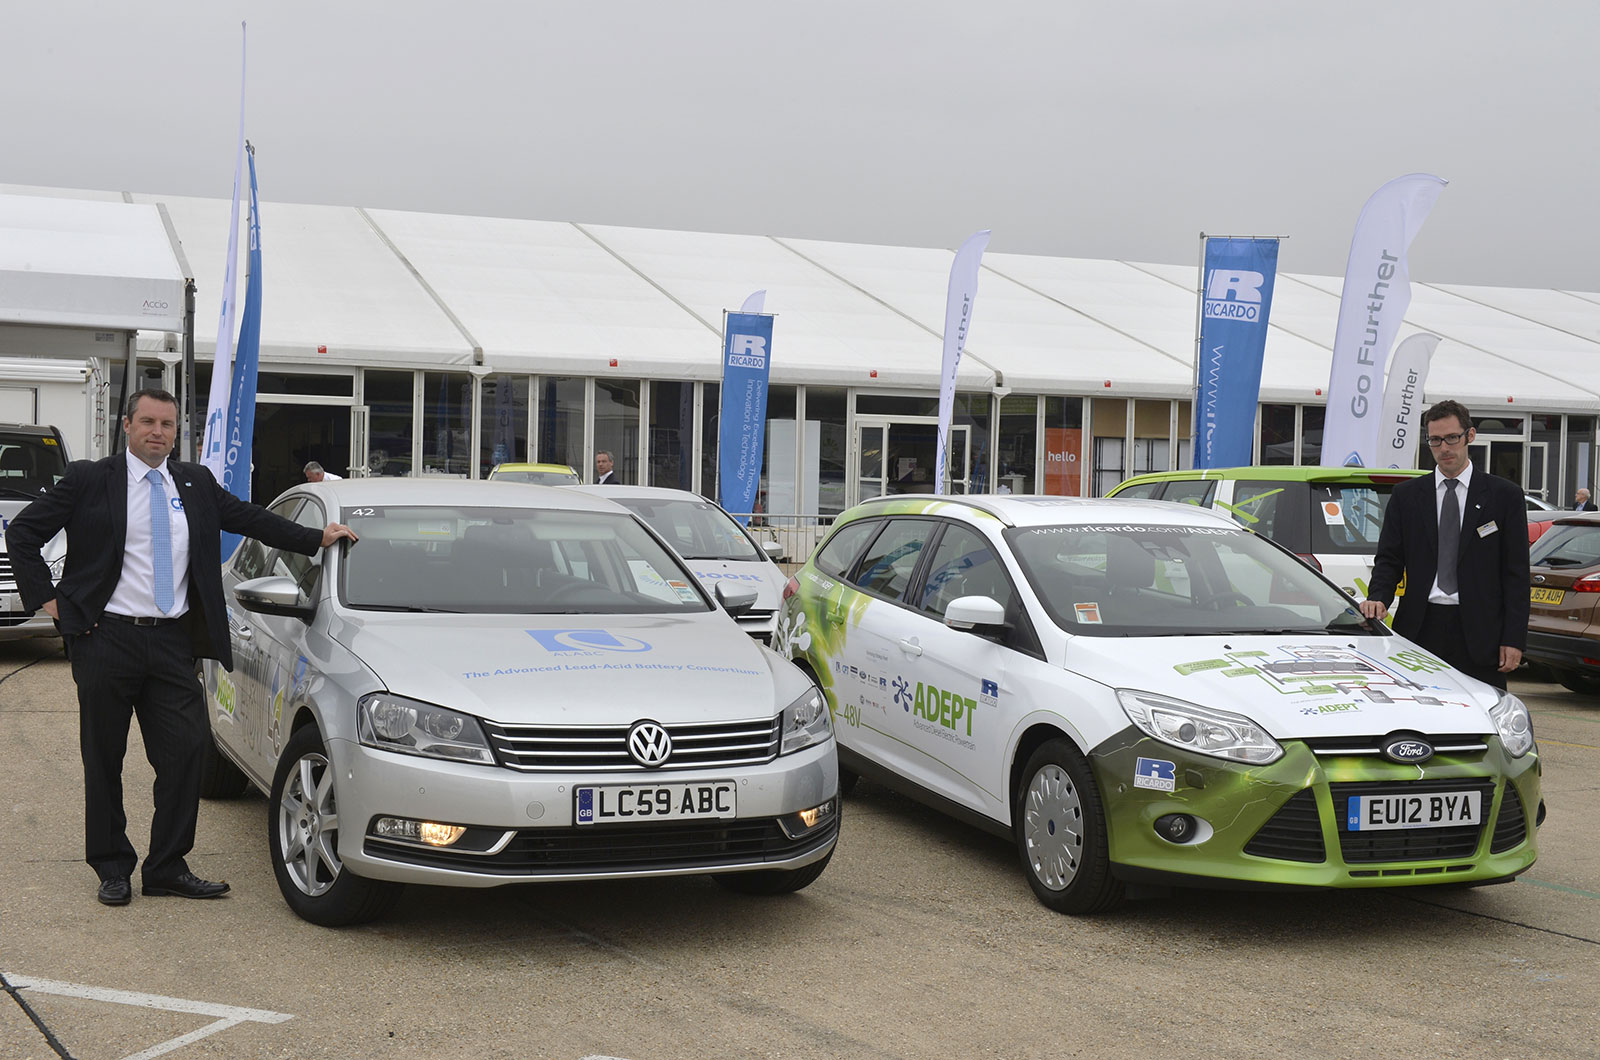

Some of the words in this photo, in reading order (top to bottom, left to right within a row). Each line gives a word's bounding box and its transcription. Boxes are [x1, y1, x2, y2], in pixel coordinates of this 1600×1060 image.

[1206, 302, 1257, 320] RICARDO
[1357, 249, 1399, 366] Further
[730, 356, 764, 368] RICARDO
[743, 379, 755, 423] Innovation
[752, 380, 763, 422] Delivering
[1351, 374, 1371, 419] Go
[1396, 368, 1419, 425] Further
[749, 423, 760, 466] Excellence
[1392, 427, 1407, 450] Go
[737, 433, 751, 481] Technology
[1048, 450, 1076, 462] hello
[352, 508, 375, 516] 42
[1031, 524, 1240, 537] www.ricardo.com/ADEPT
[1546, 590, 1563, 602] AUH
[462, 671, 490, 679] The
[494, 665, 562, 676] Advanced
[565, 663, 632, 671] Lead-Acid
[635, 663, 683, 671] Battery
[843, 703, 861, 728] 48V
[913, 681, 977, 737] ADEPT
[1318, 702, 1360, 714] ADEPT
[1399, 743, 1423, 756] Ford
[1136, 776, 1173, 790] RICARDO
[599, 789, 671, 817] LC59
[680, 786, 730, 814] ABC
[1369, 798, 1422, 825] EU12
[1429, 795, 1472, 822] BYA
[579, 809, 593, 818] GB
